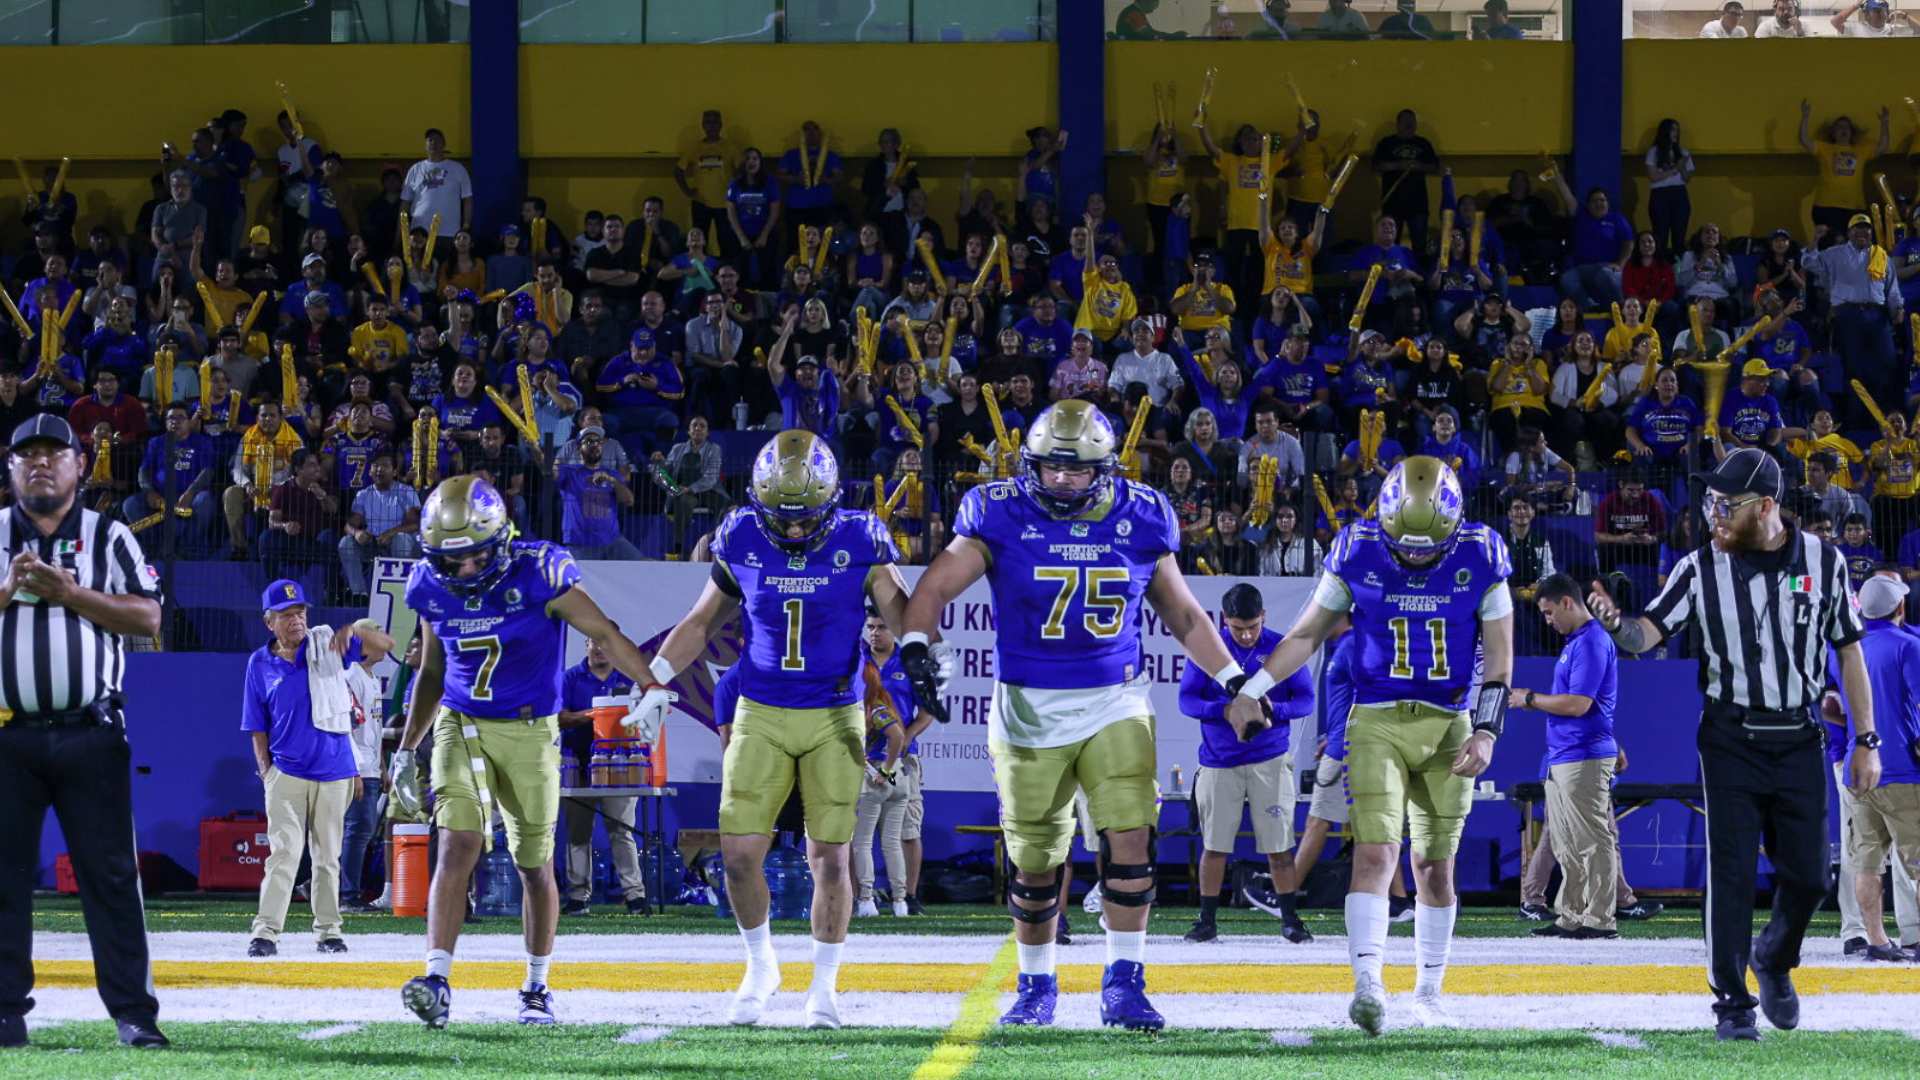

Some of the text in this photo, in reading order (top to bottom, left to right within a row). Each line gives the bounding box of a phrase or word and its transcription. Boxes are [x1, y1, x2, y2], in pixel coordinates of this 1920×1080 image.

[346, 454, 367, 488] 7
[1048, 544, 1112, 553] AUTENTICOS
[1061, 552, 1099, 561] TIGRES
[764, 576, 829, 585] AUTENTICOS
[777, 584, 816, 594] TIGRES
[1034, 566, 1130, 639] 75
[1384, 594, 1451, 604] AUTENTICOS
[1398, 603, 1437, 612] TIGRES
[964, 603, 993, 631] KN
[1796, 604, 1808, 624] L
[781, 598, 805, 671] 1
[1388, 617, 1450, 680] 11
[457, 635, 501, 700] 7
[955, 648, 1184, 683] 'RE GLE
